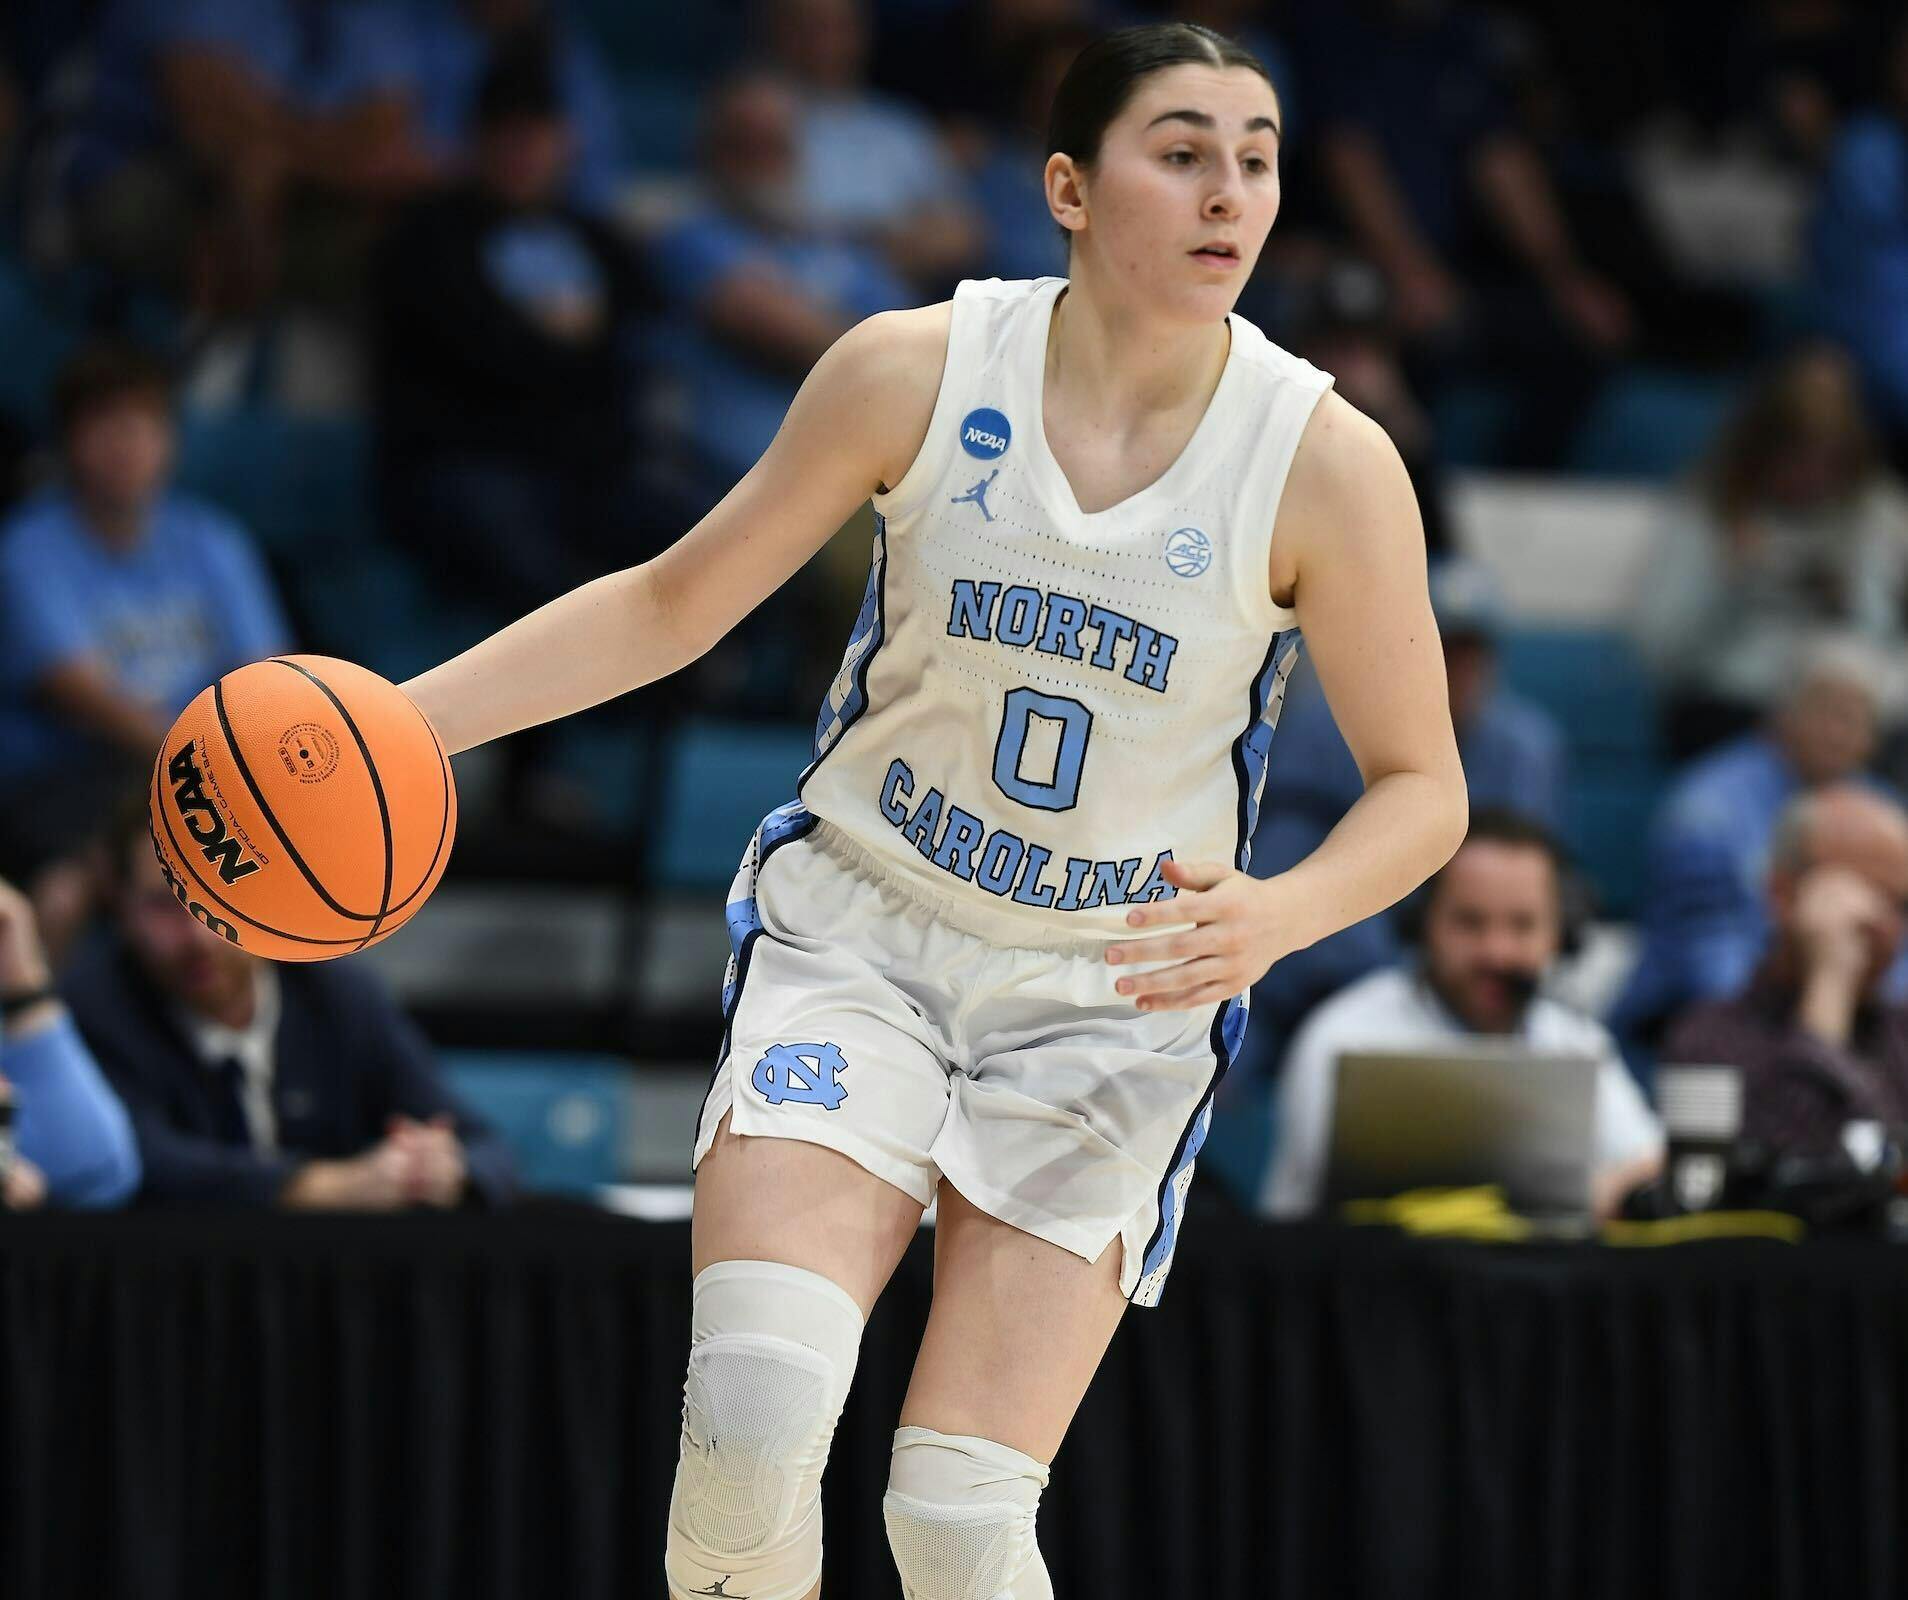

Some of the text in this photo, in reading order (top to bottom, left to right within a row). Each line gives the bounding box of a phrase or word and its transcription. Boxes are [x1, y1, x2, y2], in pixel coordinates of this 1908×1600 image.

[964, 427, 1007, 452] NCAA
[947, 579, 1178, 693] NORTH
[168, 738, 263, 887] NCAA
[199, 734, 270, 865] OFFICIAL GAME BALL
[992, 686, 1094, 813] 0
[879, 757, 1180, 911] CAROLINA
